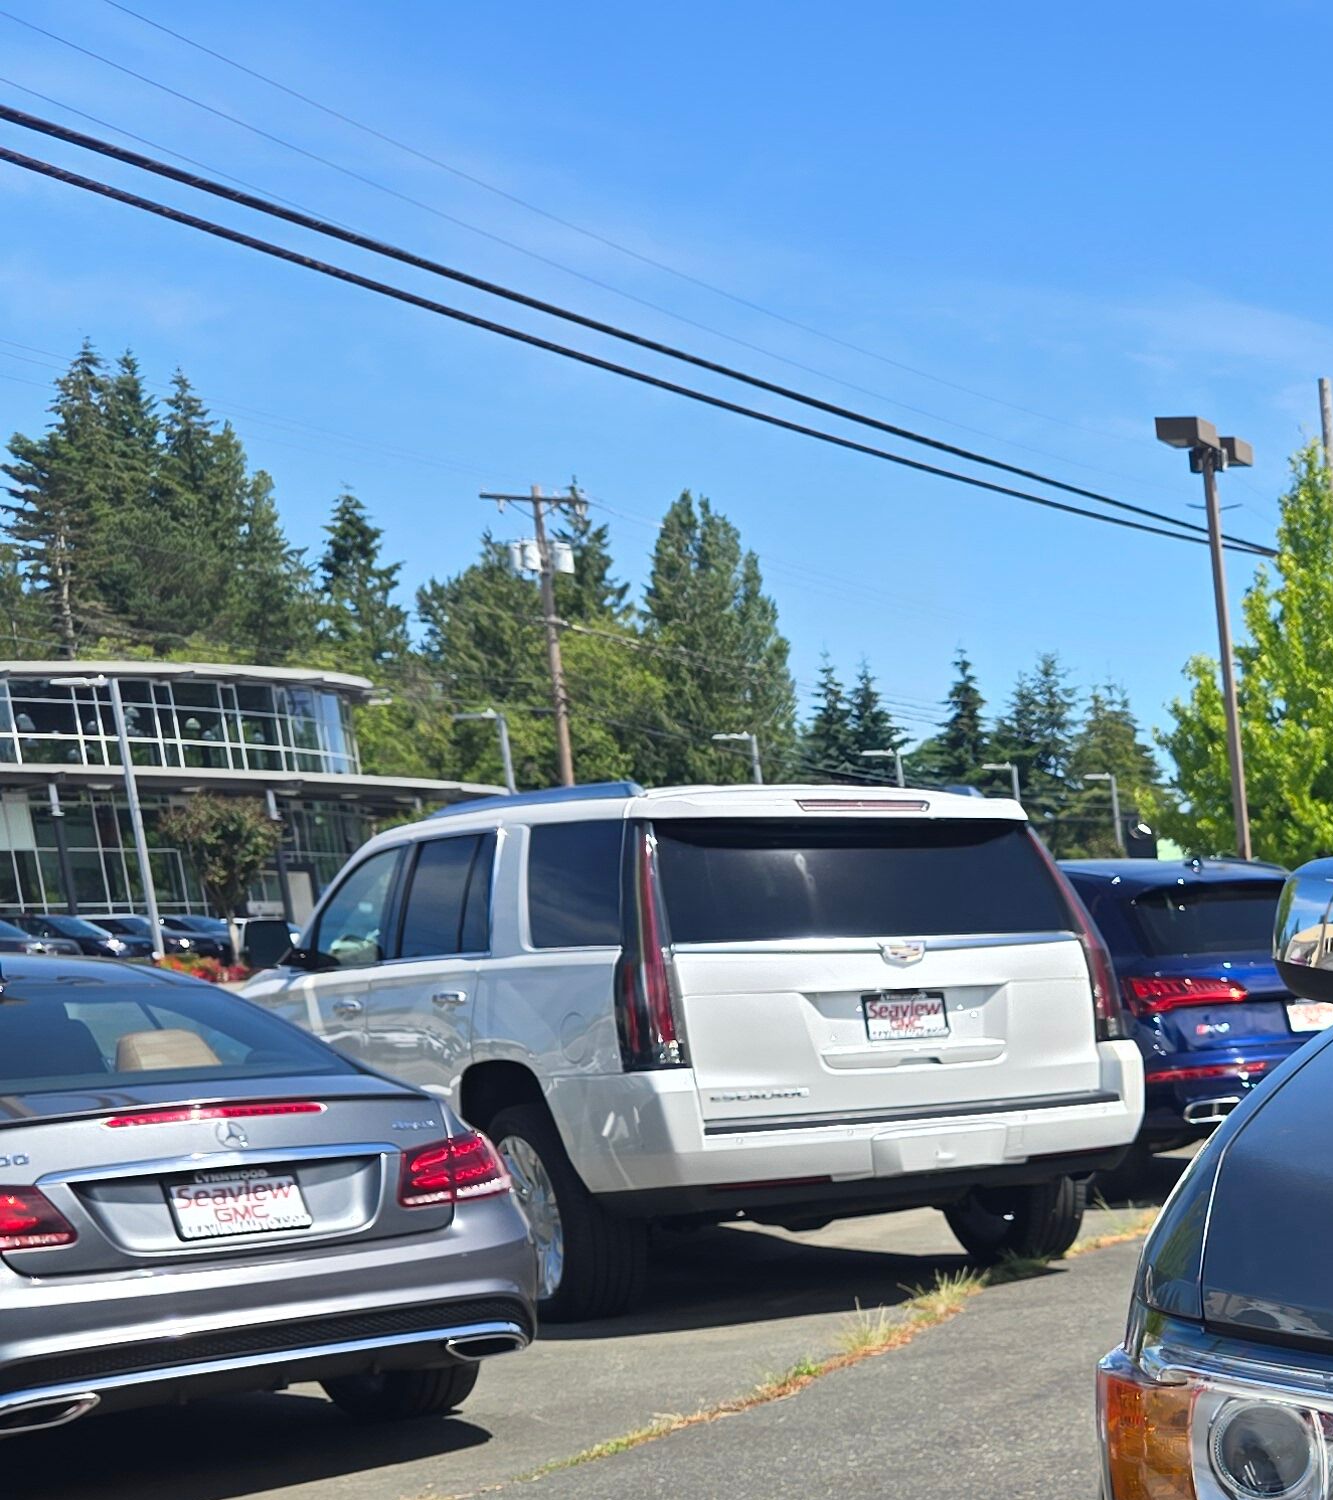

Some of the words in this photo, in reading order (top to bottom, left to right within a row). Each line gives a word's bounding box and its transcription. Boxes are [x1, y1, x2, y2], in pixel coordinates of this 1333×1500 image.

[869, 1000, 942, 1019] Seaview
[176, 1180, 292, 1209] Seaview
[214, 1204, 270, 1222] GMC
